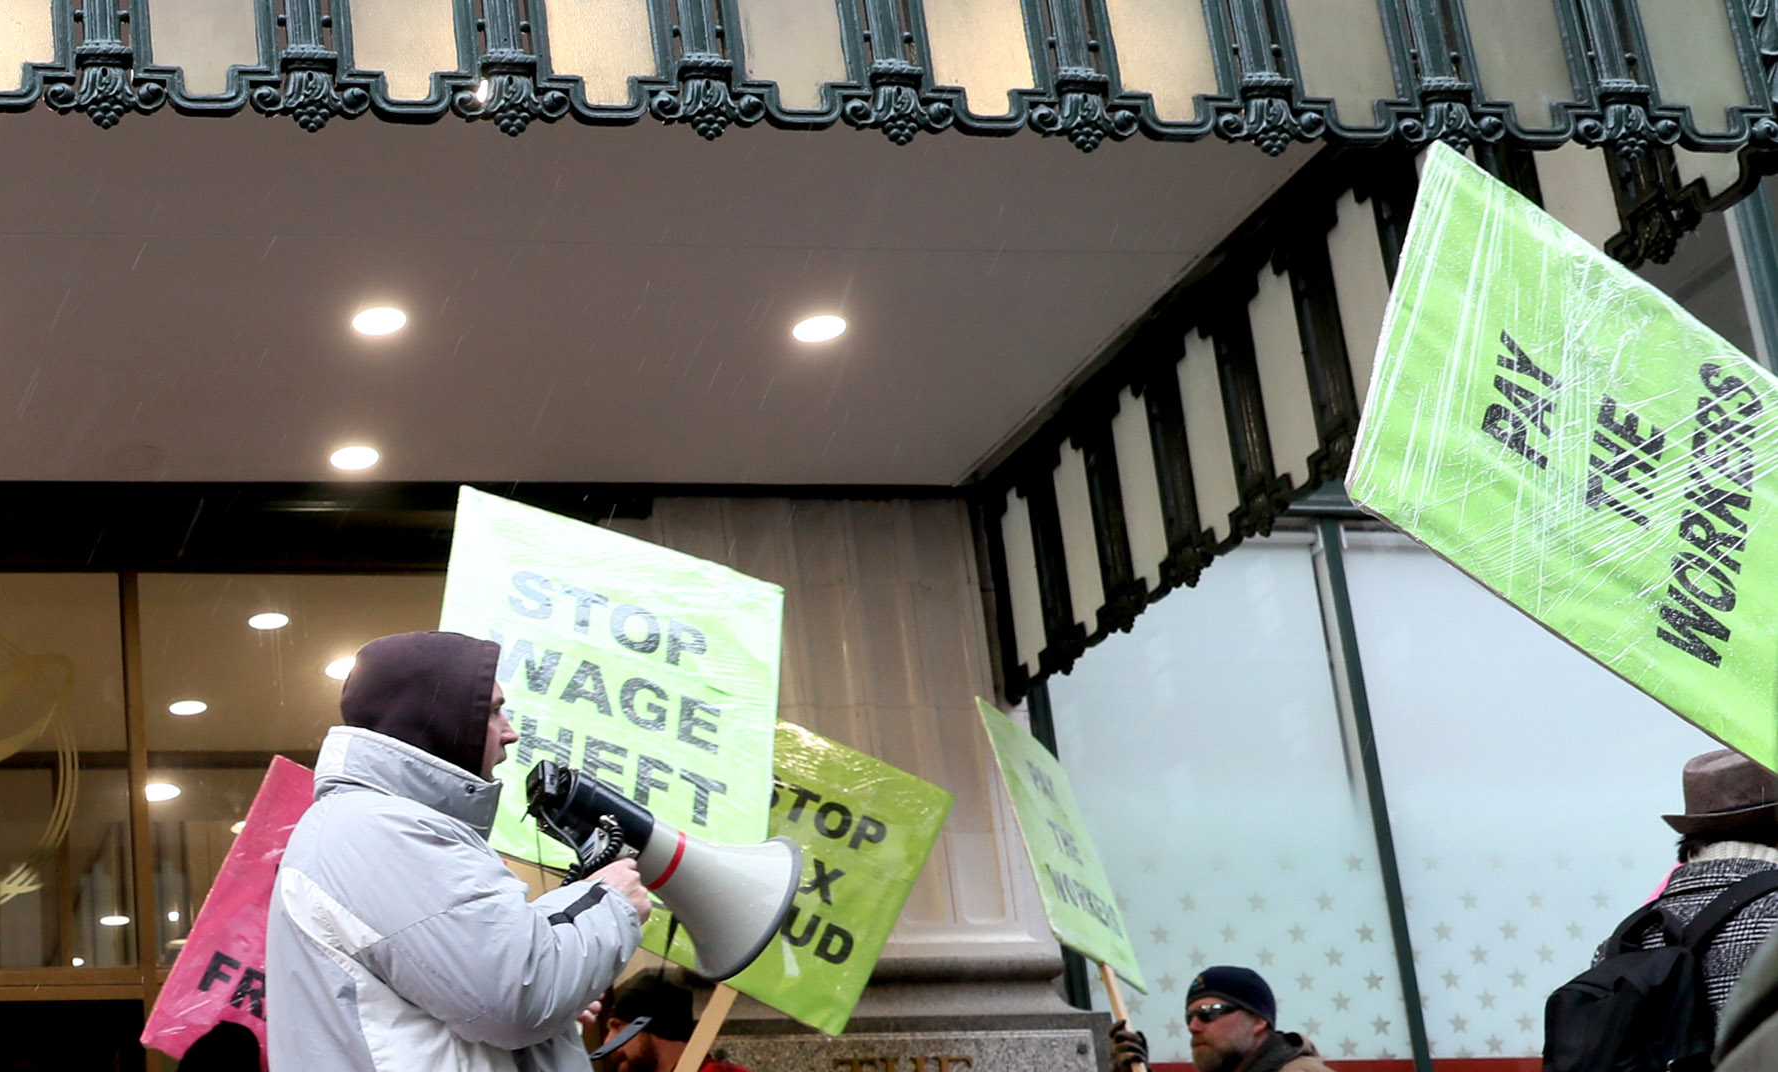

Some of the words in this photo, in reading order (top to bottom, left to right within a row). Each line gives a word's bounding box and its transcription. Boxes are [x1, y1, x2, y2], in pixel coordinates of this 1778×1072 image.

[1482, 329, 1562, 470] PAY
[1586, 393, 1666, 531] THE
[1656, 362, 1763, 669] WORKERS
[508, 570, 708, 666] STOP
[490, 629, 722, 755] WAGE
[503, 708, 728, 827] HEFT
